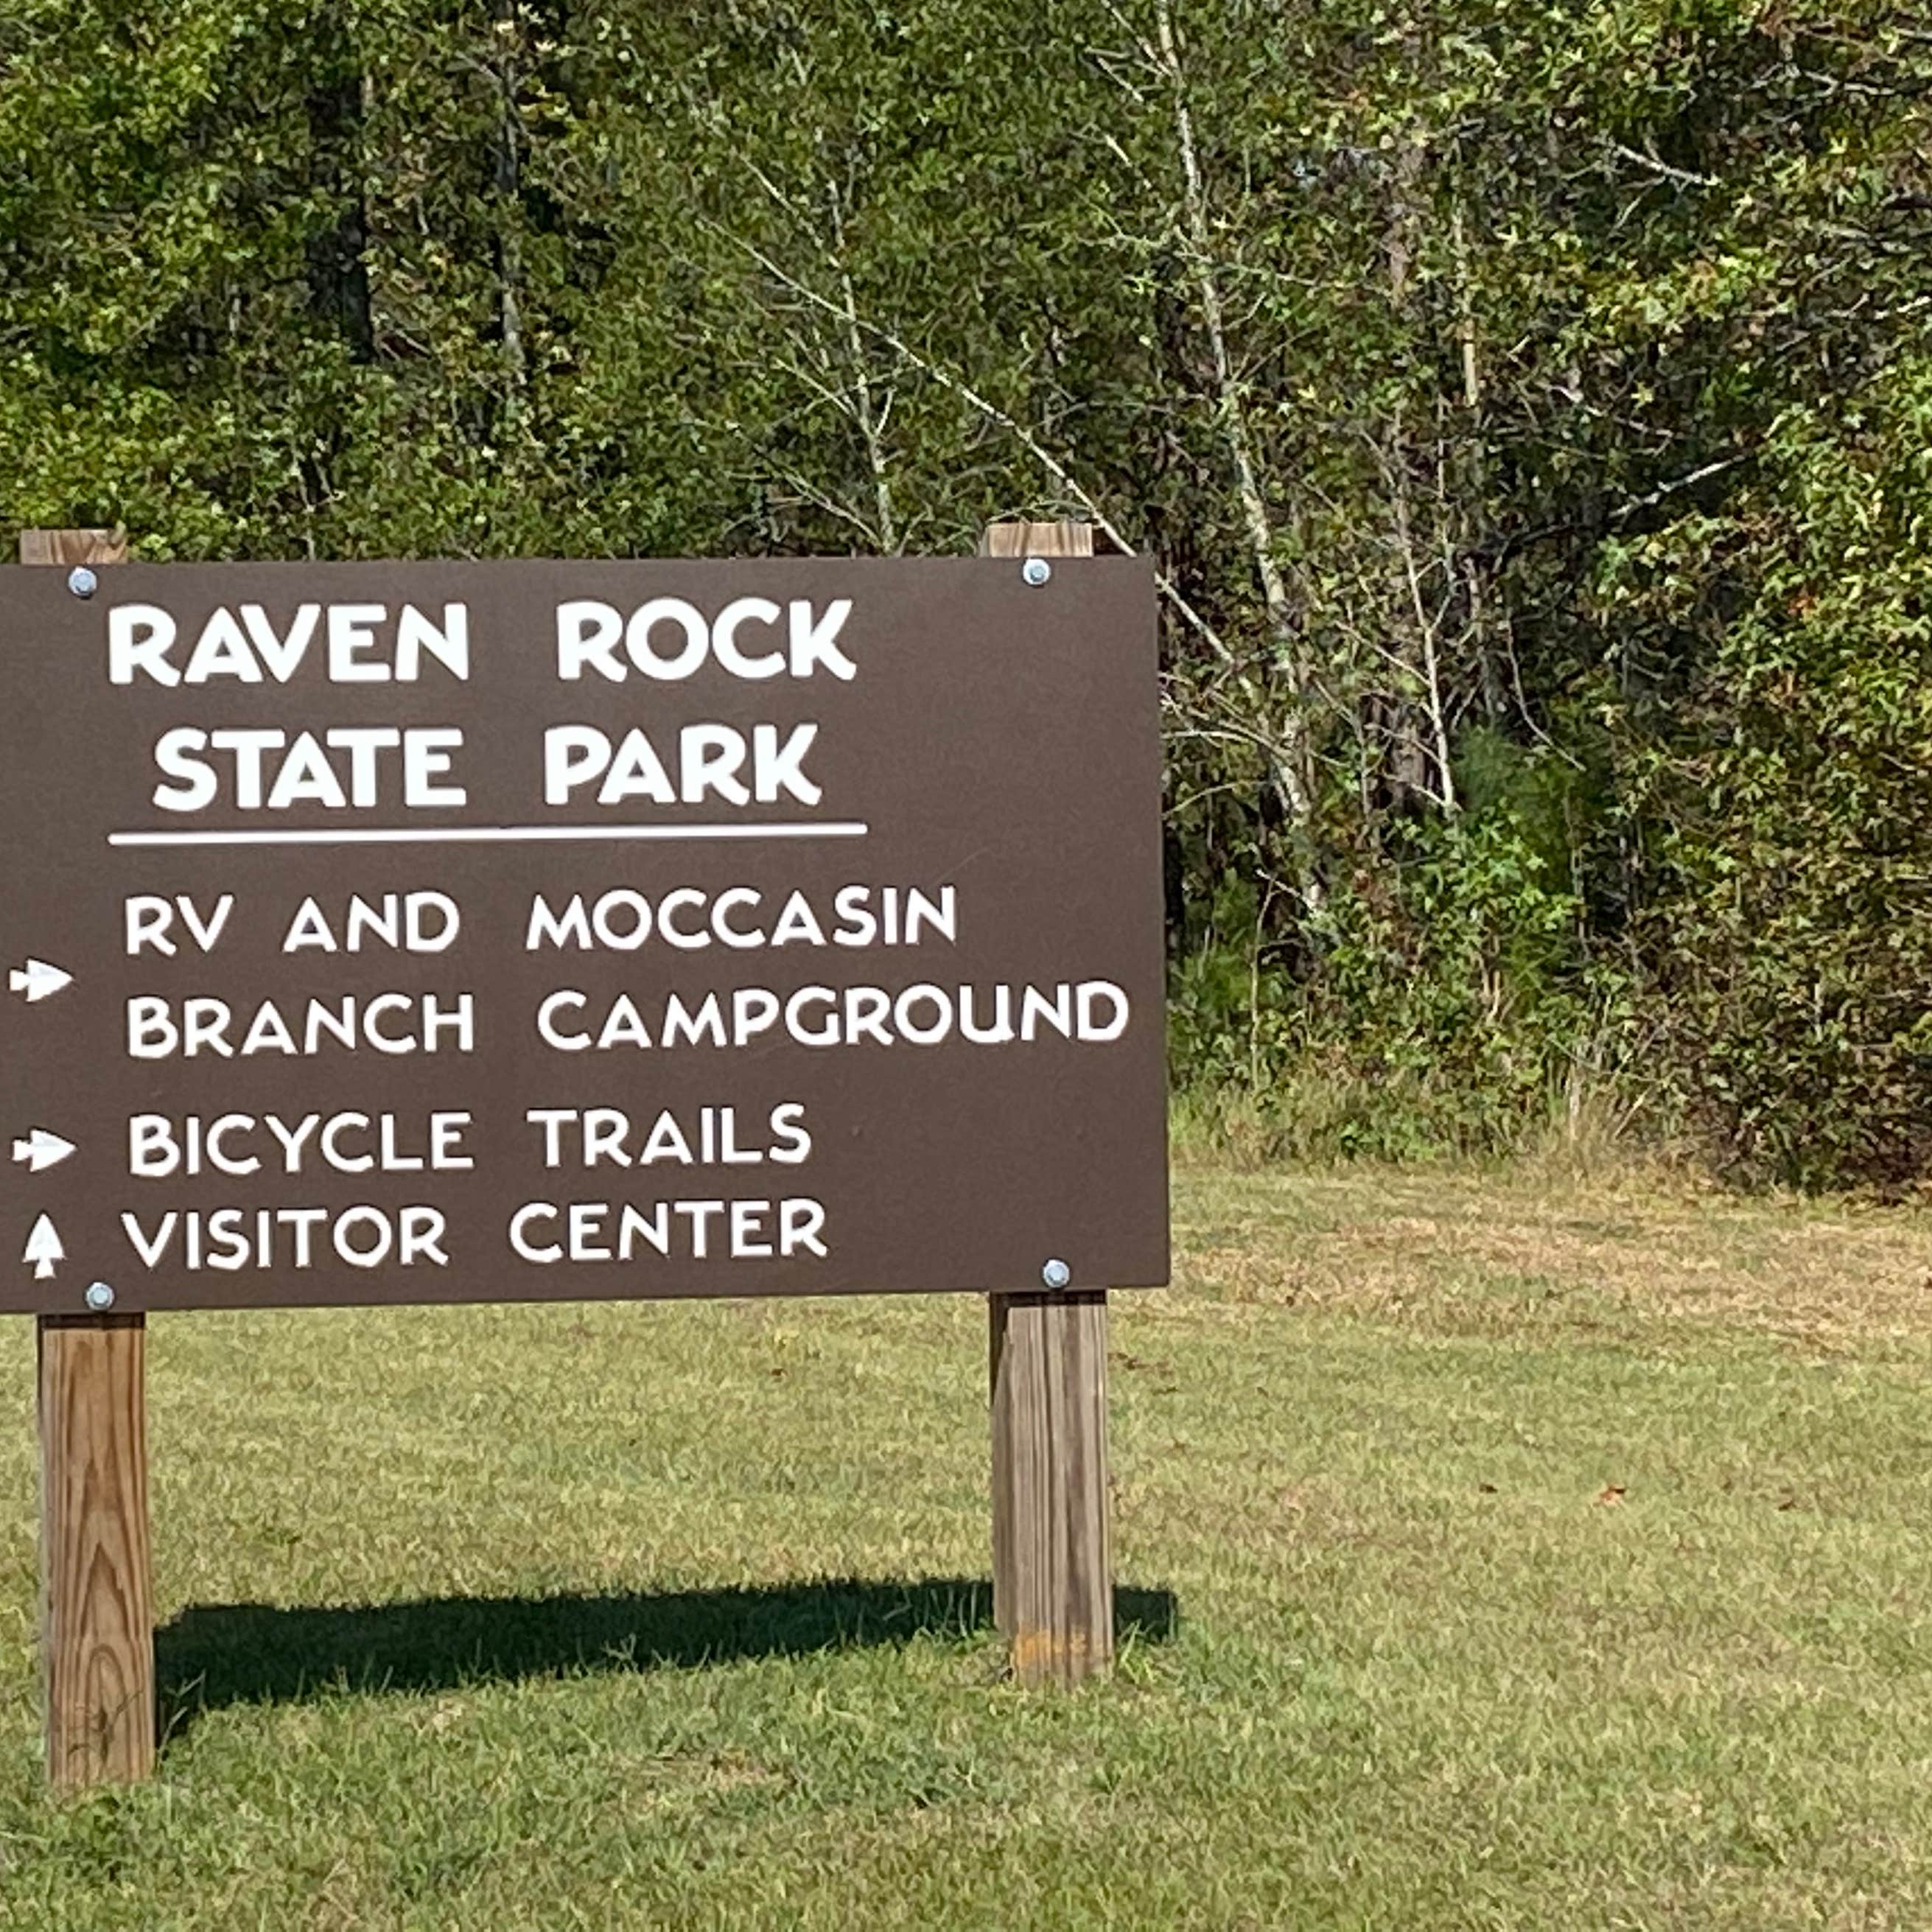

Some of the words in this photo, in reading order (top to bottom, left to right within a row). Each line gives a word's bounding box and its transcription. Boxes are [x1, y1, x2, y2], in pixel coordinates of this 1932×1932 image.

[108, 603, 469, 687] RAVEN
[556, 598, 857, 683] ROCK
[153, 727, 466, 812] STATE
[545, 723, 822, 807] PARK
[125, 895, 234, 956] RV
[284, 892, 461, 953] AND
[526, 886, 956, 951] MOCCASIN
[128, 993, 474, 1060] BRANCH
[538, 981, 1130, 1051] CAMPGROUND
[130, 1112, 474, 1177] BICYCLE
[527, 1103, 812, 1169] TRAILS
[121, 1205, 449, 1270] VISITOR
[510, 1198, 828, 1266] CENTER
